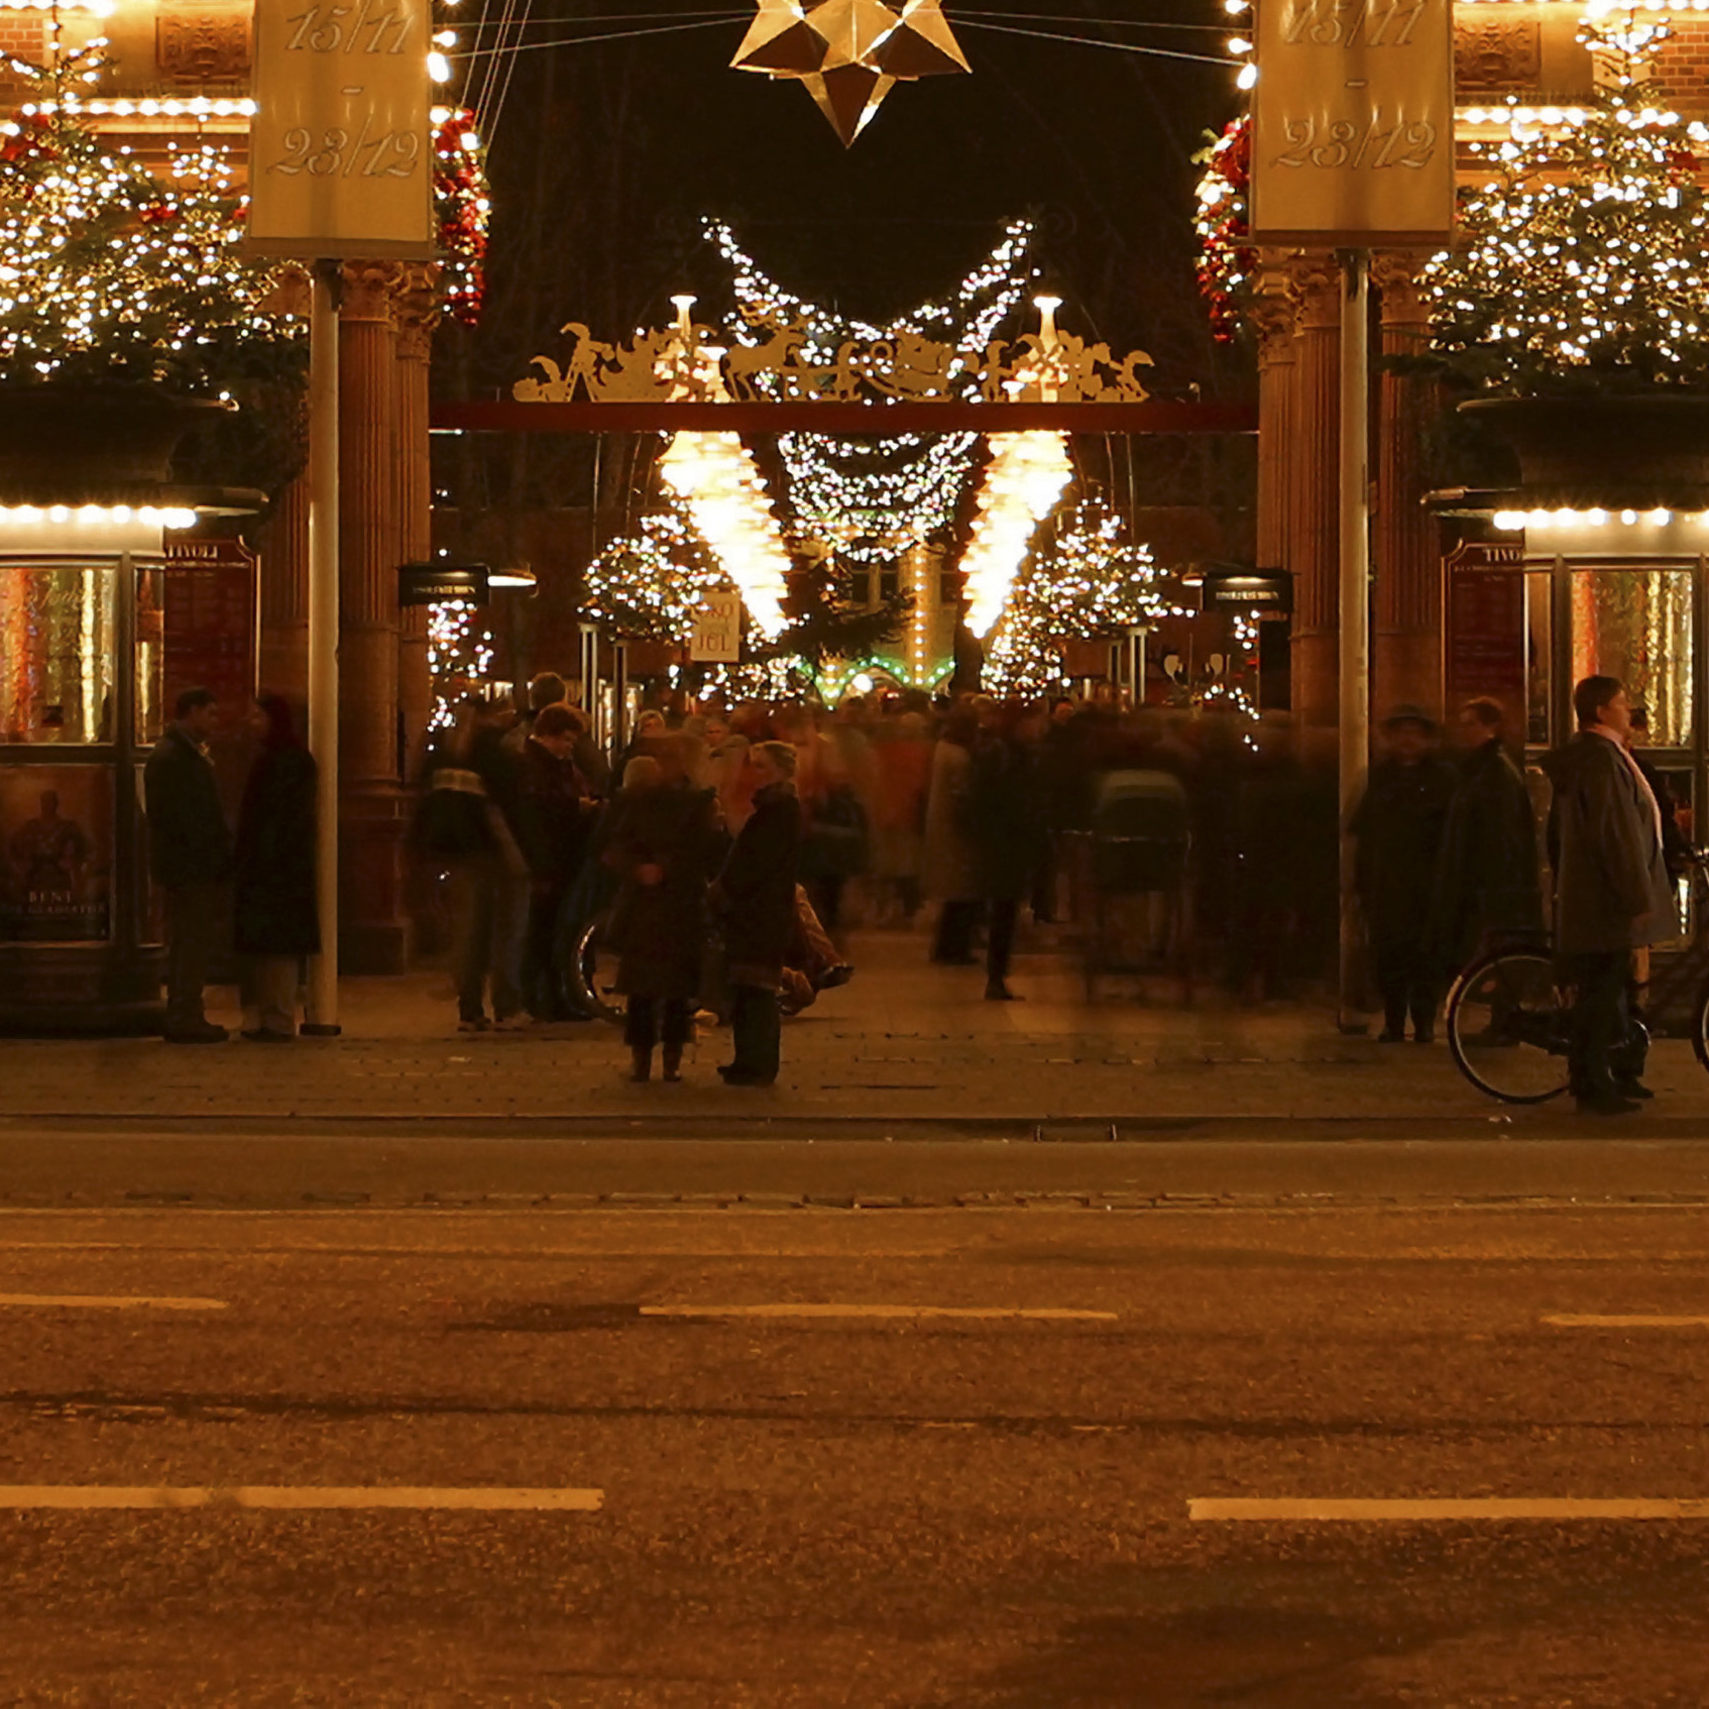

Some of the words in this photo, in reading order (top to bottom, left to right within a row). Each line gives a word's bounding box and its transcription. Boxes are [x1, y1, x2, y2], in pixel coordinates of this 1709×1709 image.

[269, 109, 420, 177] 23/12
[1270, 105, 1437, 170] 23/12
[1481, 547, 1522, 563] TIVO
